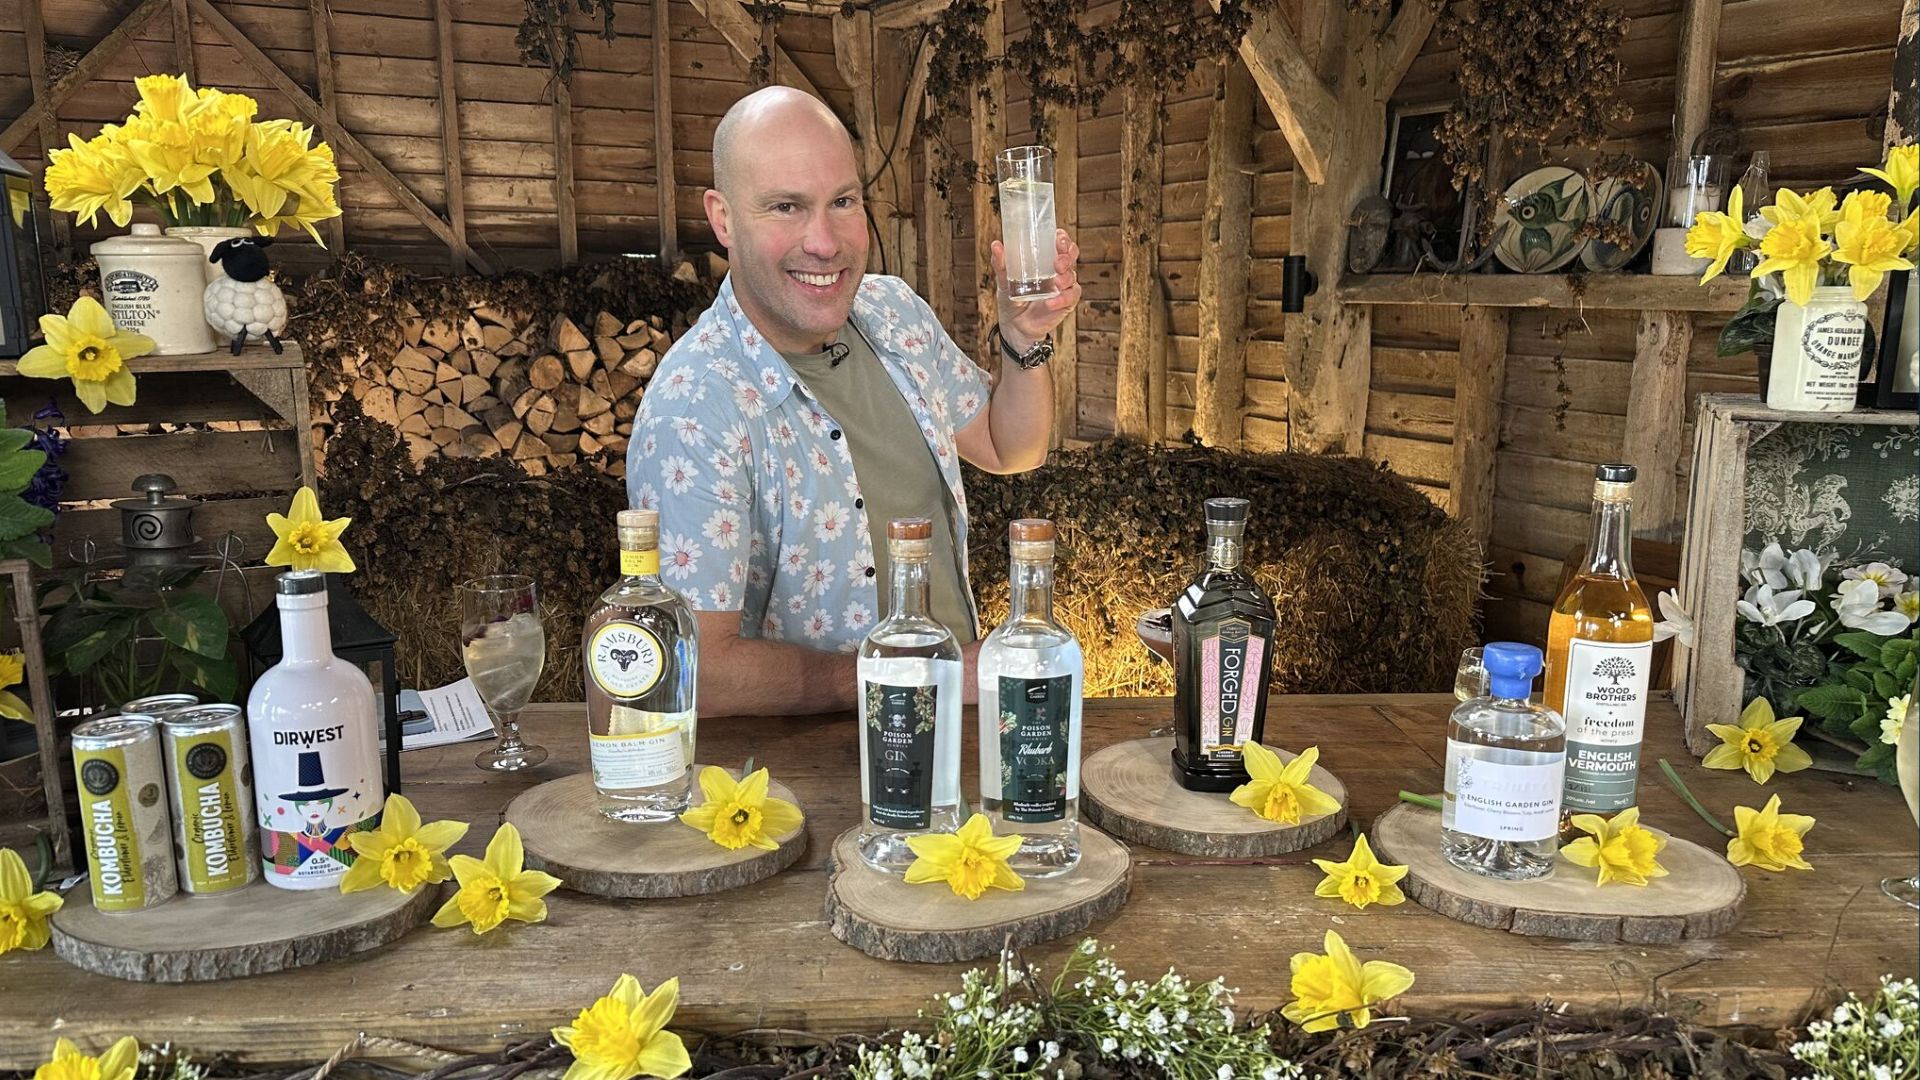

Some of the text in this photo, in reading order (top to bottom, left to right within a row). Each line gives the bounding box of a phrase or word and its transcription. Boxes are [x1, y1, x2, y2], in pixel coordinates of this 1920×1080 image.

[1828, 336, 1860, 346] DUNDEE
[1811, 340, 1836, 359] ORANGE
[598, 632, 656, 666] RAMSBURY
[1221, 648, 1241, 714] FORGED
[1586, 692, 1636, 701] BROTHERS
[1597, 686, 1629, 694] WOOD
[1222, 716, 1233, 737] GIN
[1584, 716, 1634, 728] freedom
[274, 725, 344, 745] DIRWEST
[1591, 728, 1608, 736] the
[1612, 729, 1634, 737] press
[885, 750, 908, 761] GIN
[1018, 741, 1054, 756] Rhubarb
[1016, 756, 1055, 766] VODKA
[1579, 750, 1632, 762] ENGLISH
[1568, 758, 1636, 772] VERMOUTH
[222, 792, 234, 814] Lemon
[1467, 794, 1502, 807] ENGLISH
[1542, 799, 1554, 807] GIN
[114, 811, 128, 833] Lemon
[198, 782, 229, 877] KOMBUCHA
[92, 800, 123, 895] KOMBUCHA
[298, 865, 344, 876] BOTANICAL SPIRIT
